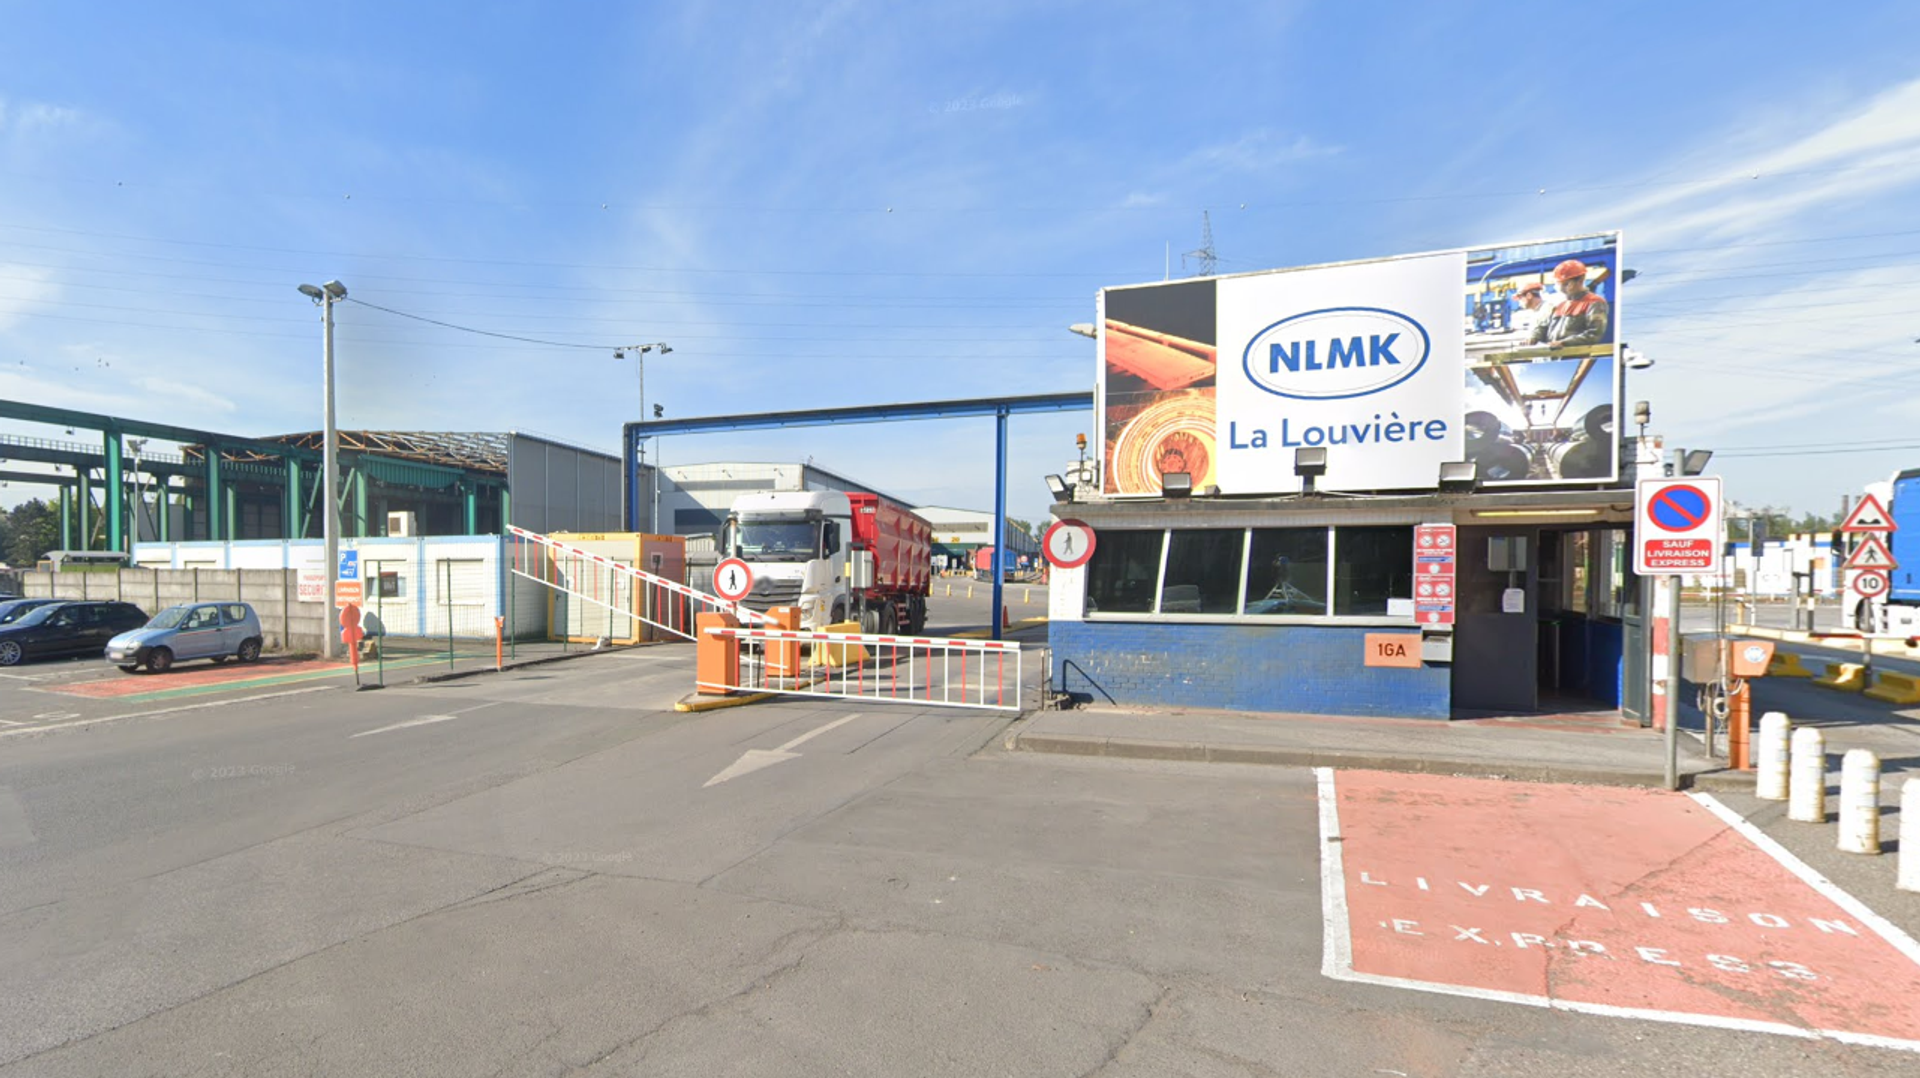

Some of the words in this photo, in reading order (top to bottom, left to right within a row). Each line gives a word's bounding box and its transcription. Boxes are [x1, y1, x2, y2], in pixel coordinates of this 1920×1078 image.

[1269, 332, 1401, 374] NLMK
[1229, 421, 1268, 449] La
[1281, 411, 1448, 448] Louvière
[1662, 540, 1695, 548] SAUF
[1651, 559, 1705, 567] EXPRESS
[1862, 577, 1879, 589] 10
[1360, 871, 1859, 937] LIVRAISON
